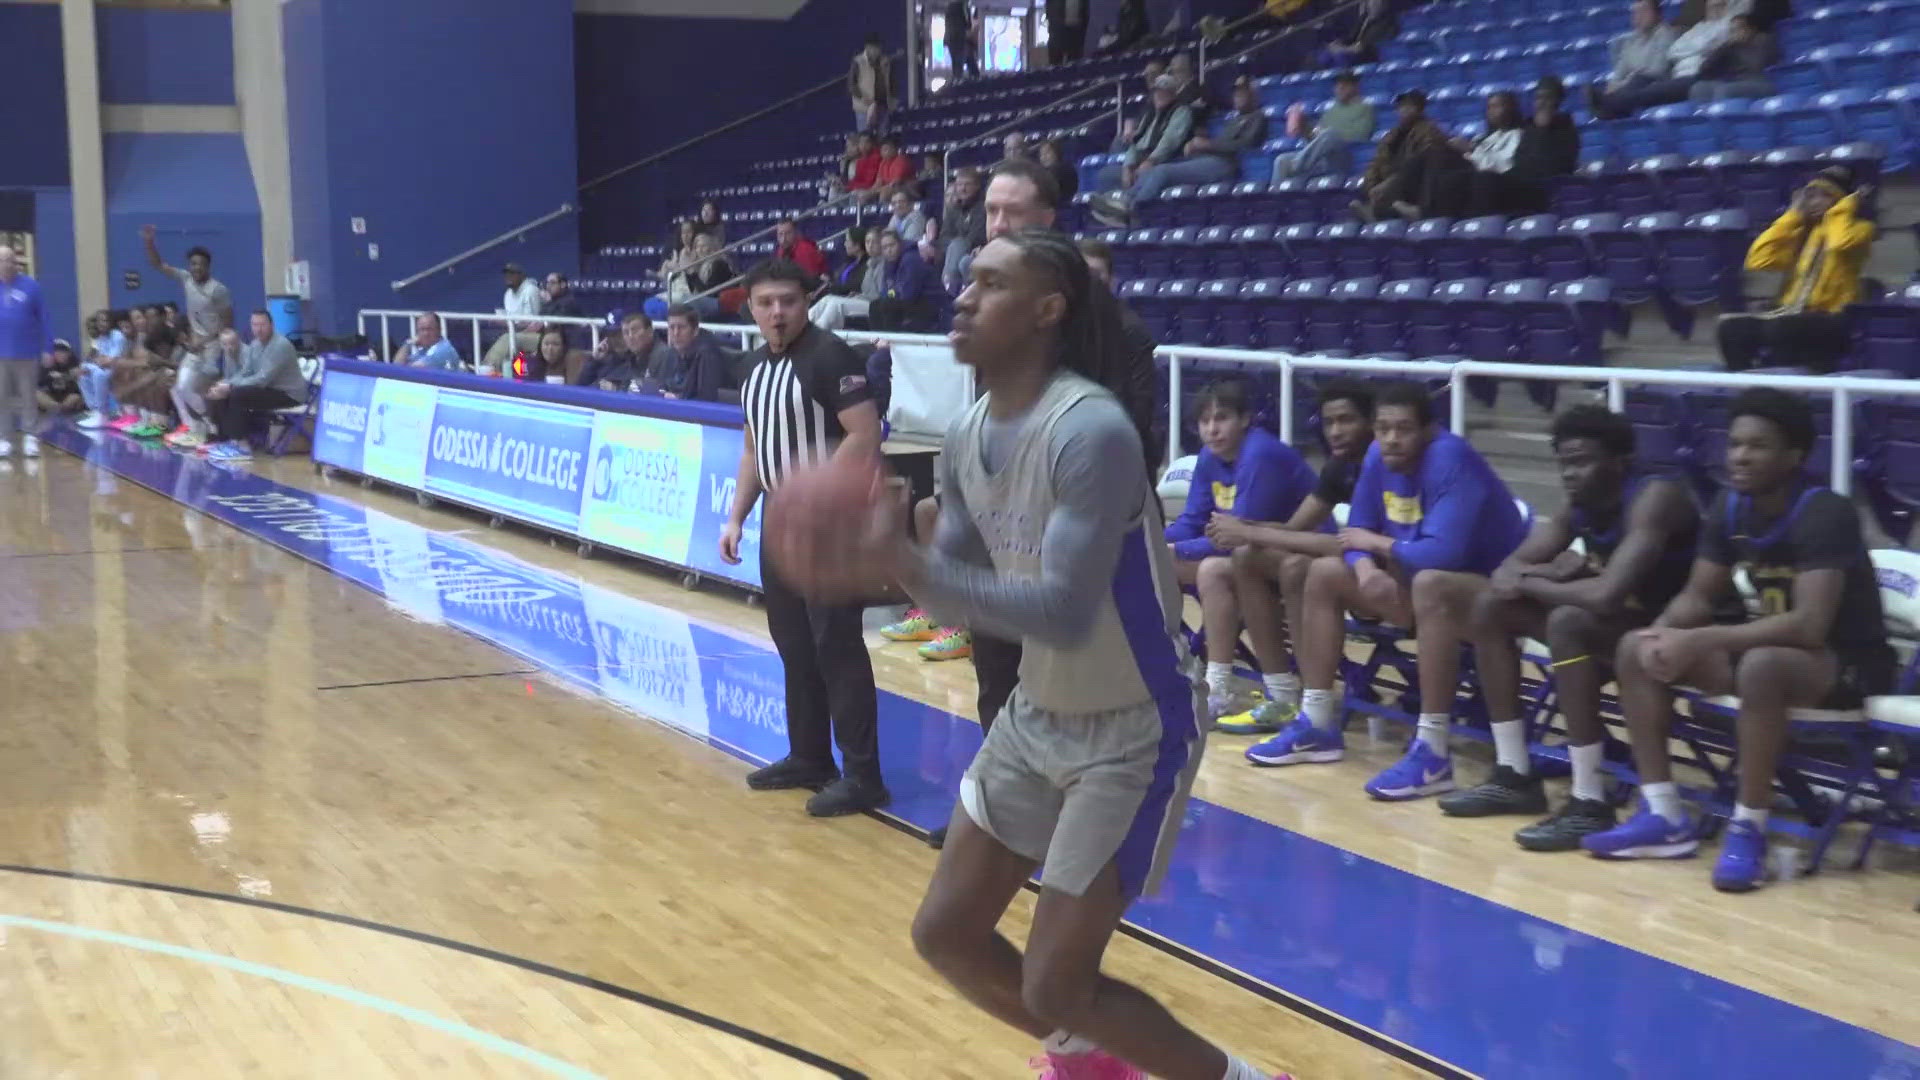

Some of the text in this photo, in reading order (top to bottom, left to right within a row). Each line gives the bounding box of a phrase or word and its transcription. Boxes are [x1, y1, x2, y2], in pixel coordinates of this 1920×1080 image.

[432, 424, 488, 470] ODESSA
[501, 436, 581, 492] COLLEGE
[623, 447, 679, 486] ODESSA
[619, 478, 688, 519] COLLEGE
